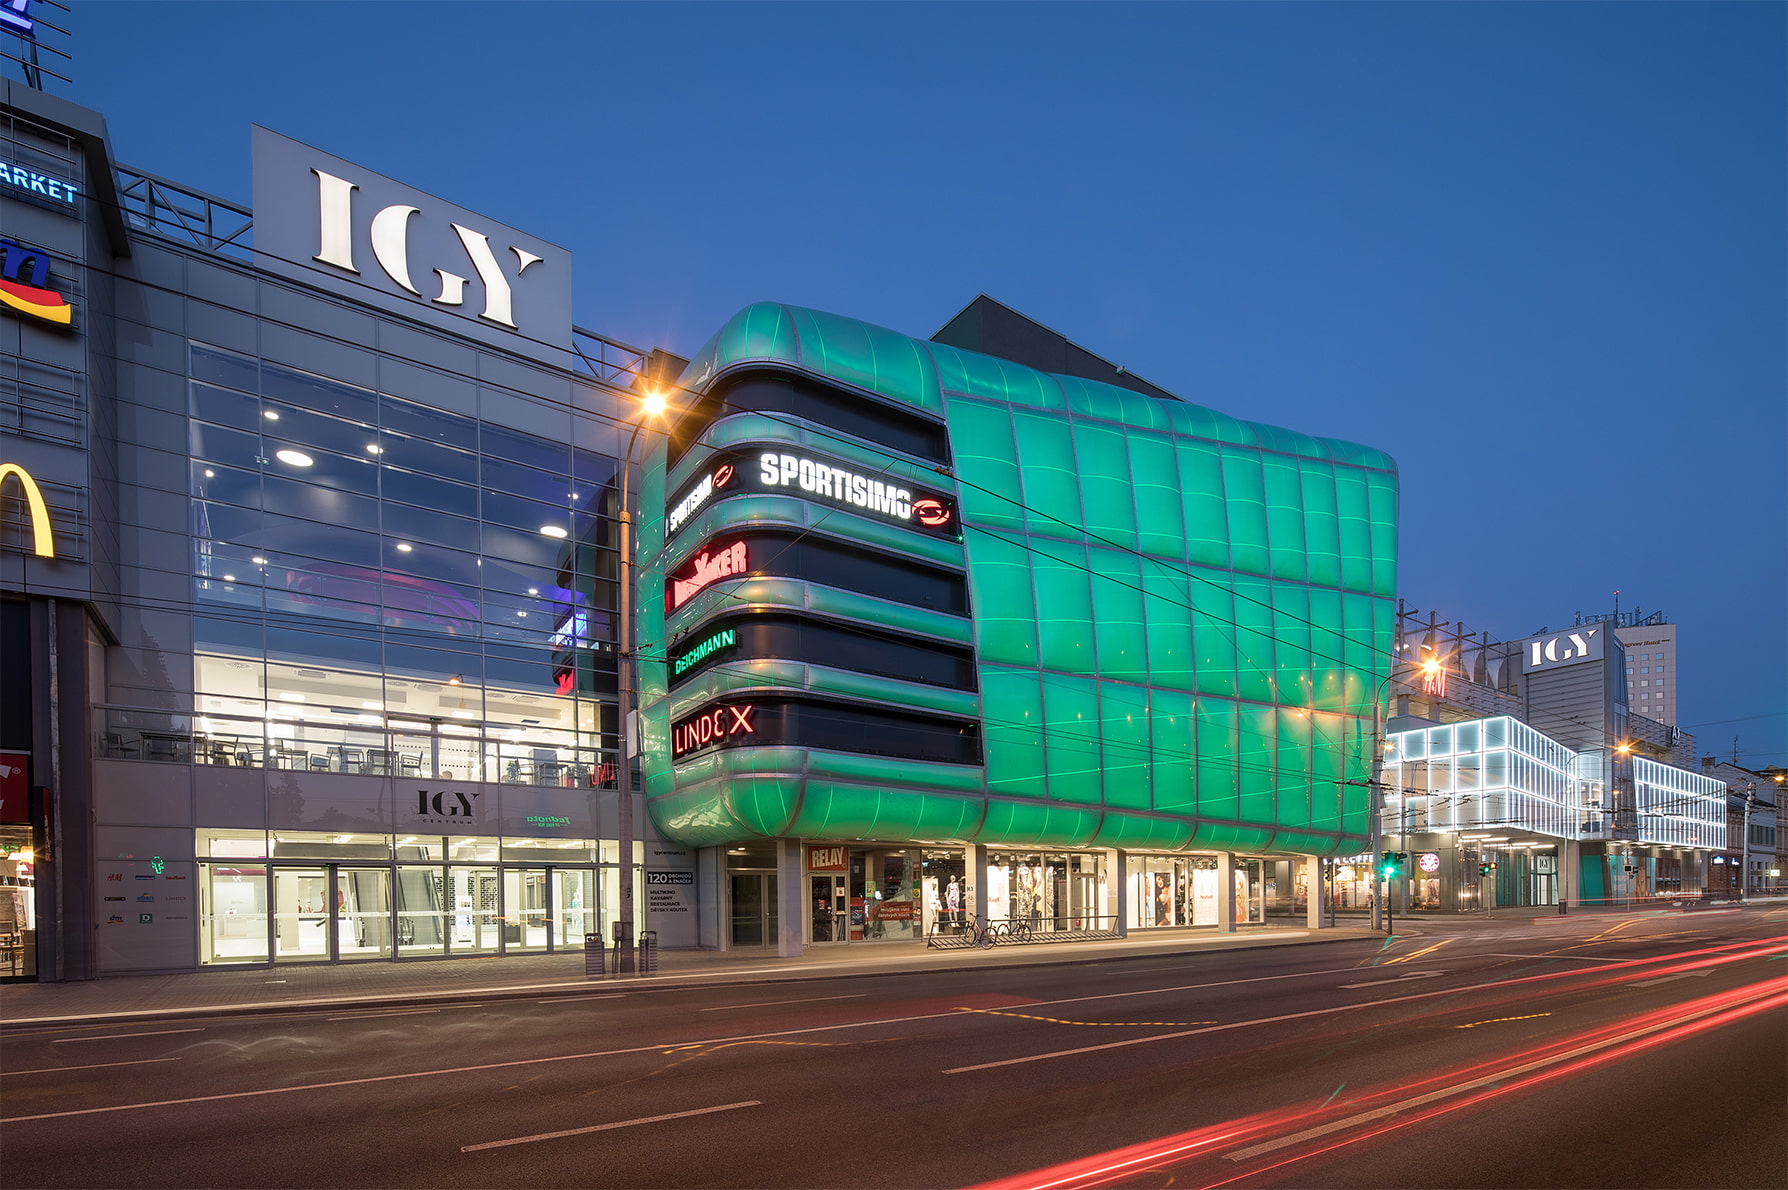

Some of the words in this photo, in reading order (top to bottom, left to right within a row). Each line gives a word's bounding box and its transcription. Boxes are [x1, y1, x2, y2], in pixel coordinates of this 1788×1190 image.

[310, 167, 544, 331] IGY
[760, 453, 911, 520] SPORTISIMO
[675, 629, 736, 675] DEICHMANN
[1530, 628, 1598, 667] IGY
[676, 704, 754, 754] LINDEX
[416, 790, 480, 817] IGY
[811, 846, 844, 868] RELAY
[1342, 854, 1375, 864] COFFE
[648, 873, 668, 884] 120
